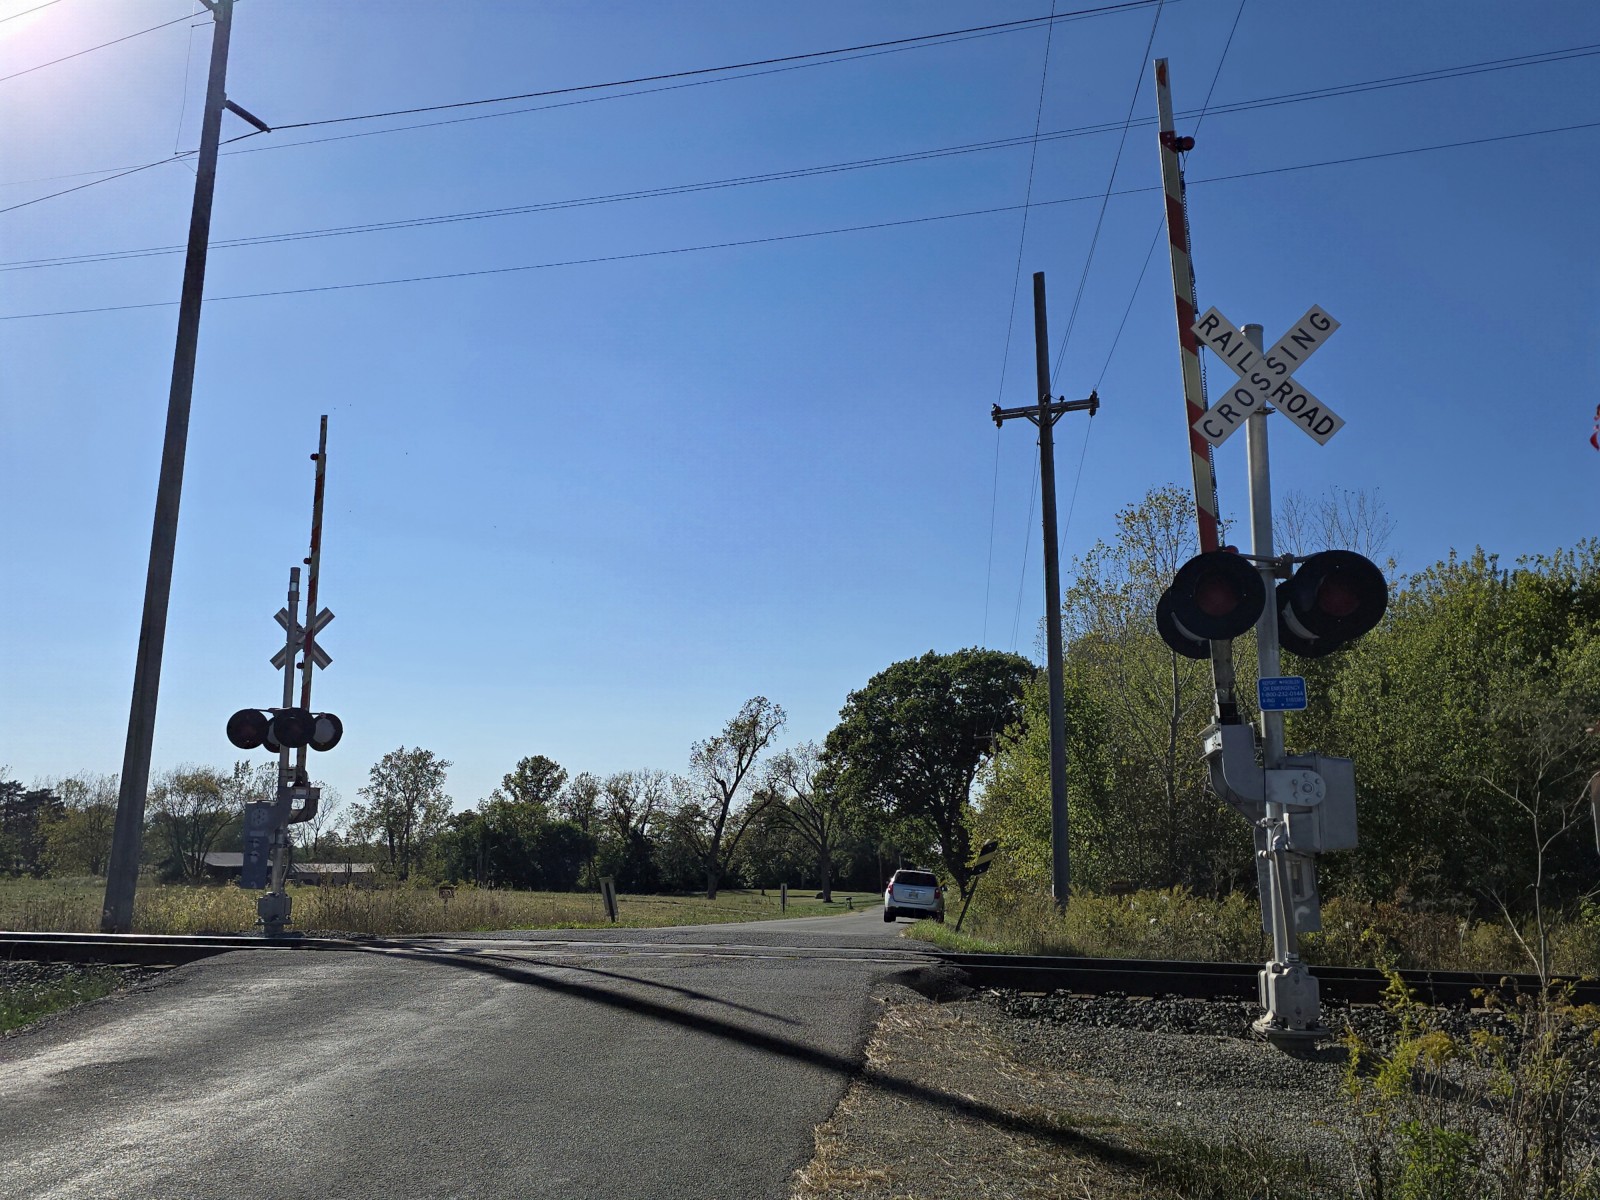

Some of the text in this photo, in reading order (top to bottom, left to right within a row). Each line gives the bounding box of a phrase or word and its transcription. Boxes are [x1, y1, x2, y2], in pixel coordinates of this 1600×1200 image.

[1199, 313, 1335, 436] RAIL ROAD
[1203, 312, 1331, 438] CROSSING
